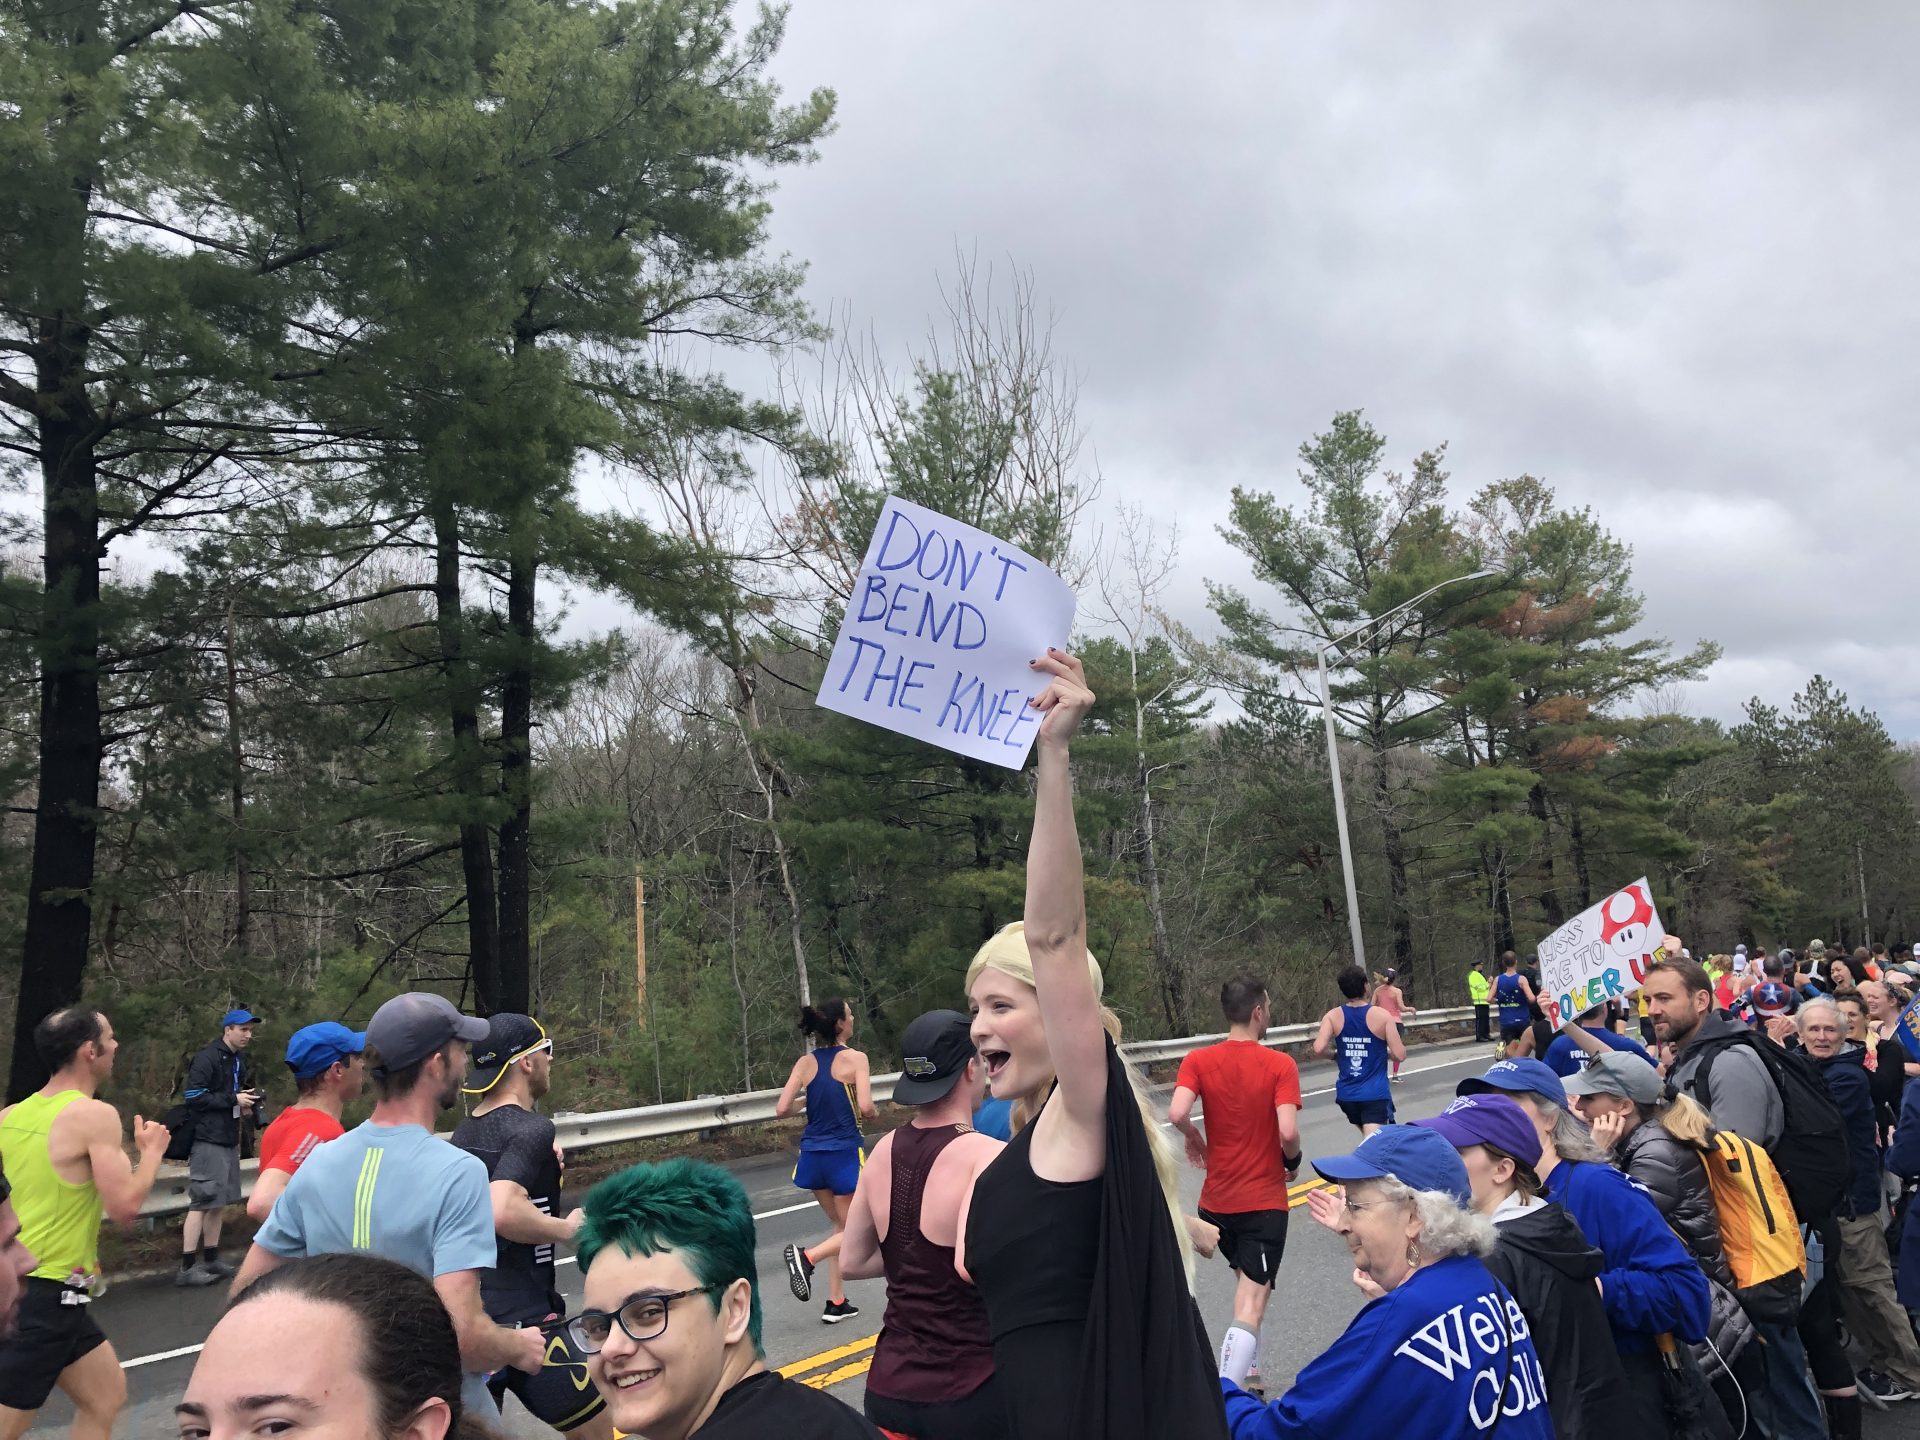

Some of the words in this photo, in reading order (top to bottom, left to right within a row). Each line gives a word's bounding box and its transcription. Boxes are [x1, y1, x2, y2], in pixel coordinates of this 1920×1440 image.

[876, 510, 1027, 601] DON'T
[857, 575, 987, 649] BEND
[838, 636, 935, 713] THE
[936, 670, 1034, 748] KNEE
[1539, 919, 1584, 967] KISS
[1546, 959, 1574, 992] ME
[1573, 939, 1605, 975] TO
[1549, 968, 1624, 1030] POWER
